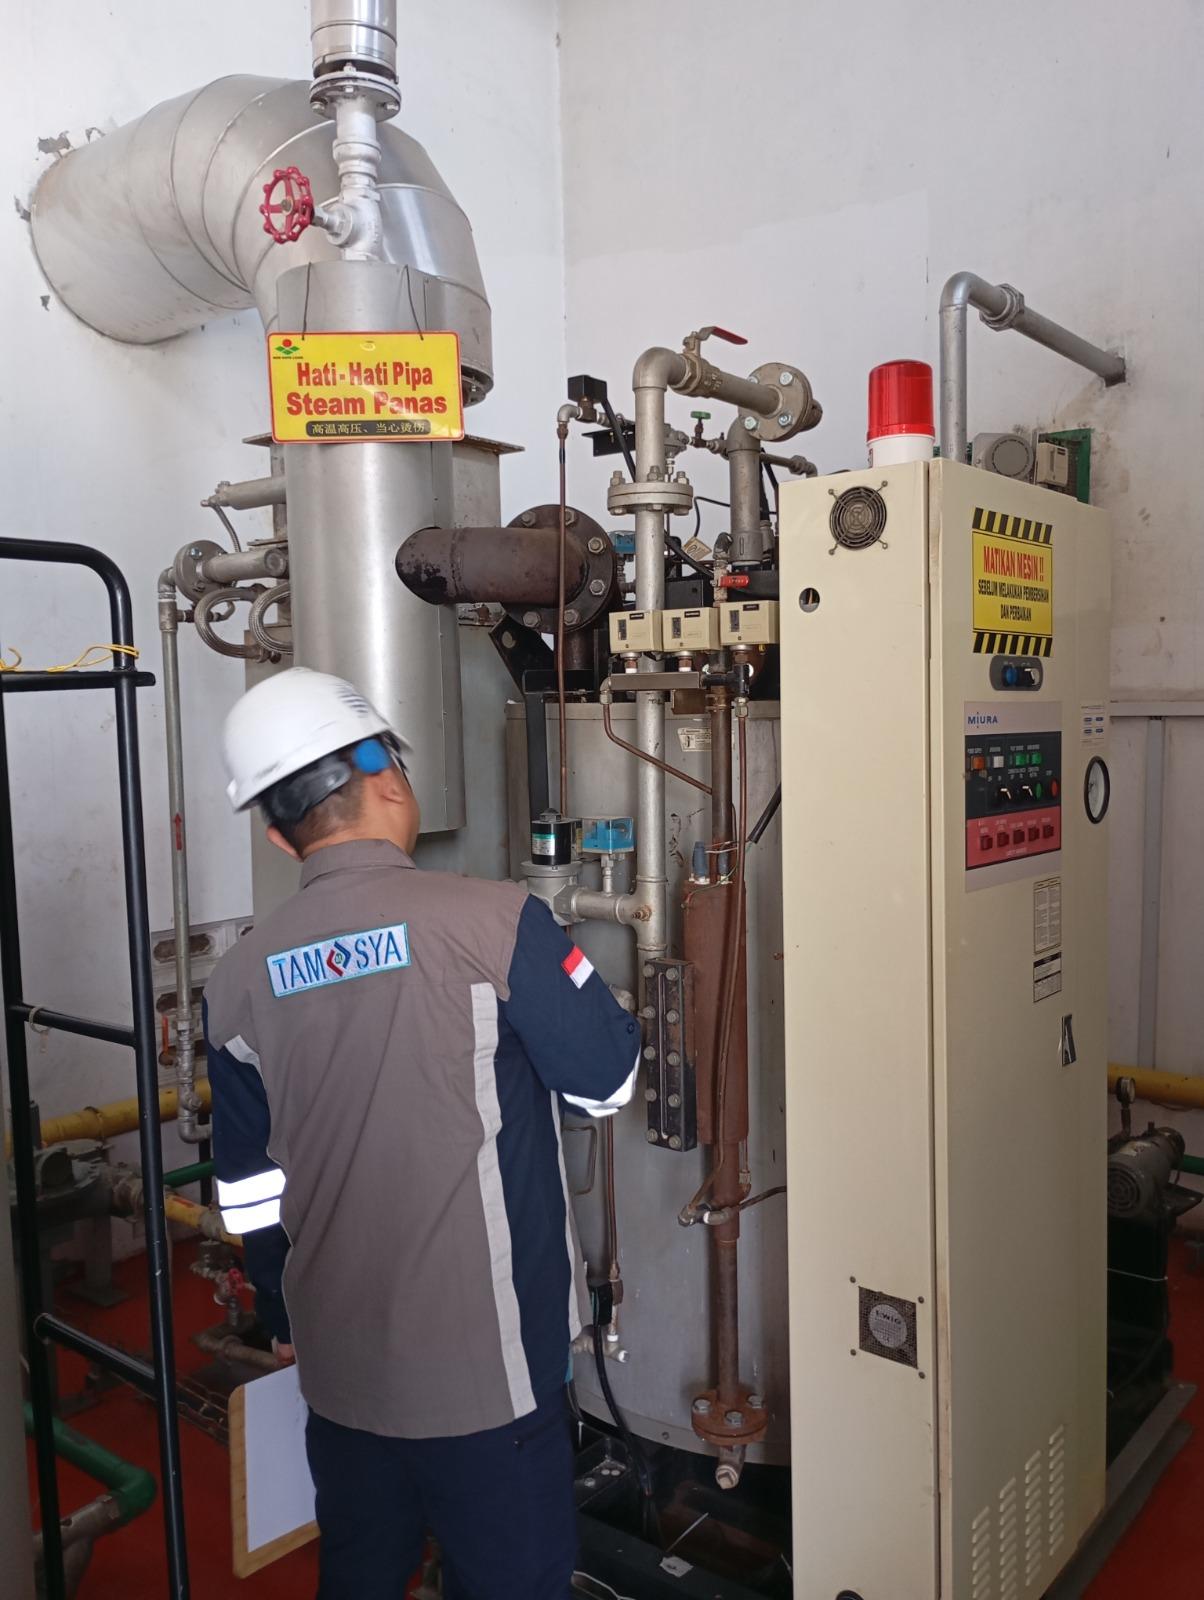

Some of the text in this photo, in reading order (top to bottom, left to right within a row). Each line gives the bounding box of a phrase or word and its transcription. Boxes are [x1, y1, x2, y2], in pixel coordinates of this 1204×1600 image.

[393, 361, 433, 390] Pipa
[287, 391, 447, 415] Steam Panas
[984, 546, 1015, 577] MATIKAN
[1017, 551, 1038, 581] MESIN
[978, 579, 998, 597] SEBELUM
[999, 581, 1022, 599] MELAKUKAN
[1001, 604, 1009, 620] DAN
